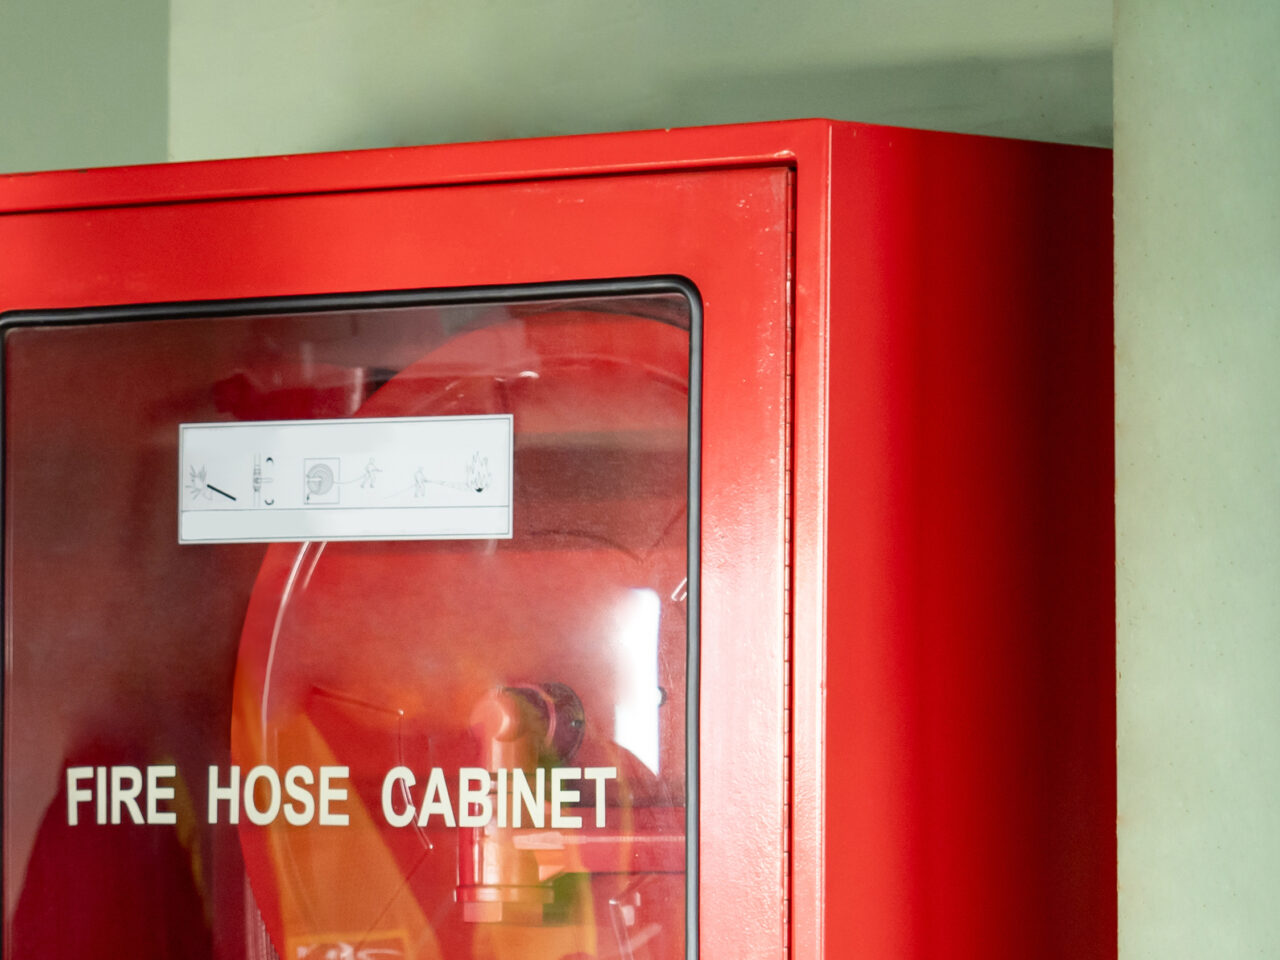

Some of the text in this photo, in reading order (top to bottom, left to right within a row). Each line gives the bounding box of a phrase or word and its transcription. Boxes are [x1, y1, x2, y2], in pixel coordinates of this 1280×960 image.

[67, 765, 617, 829] FIRE HOSE CABINET
